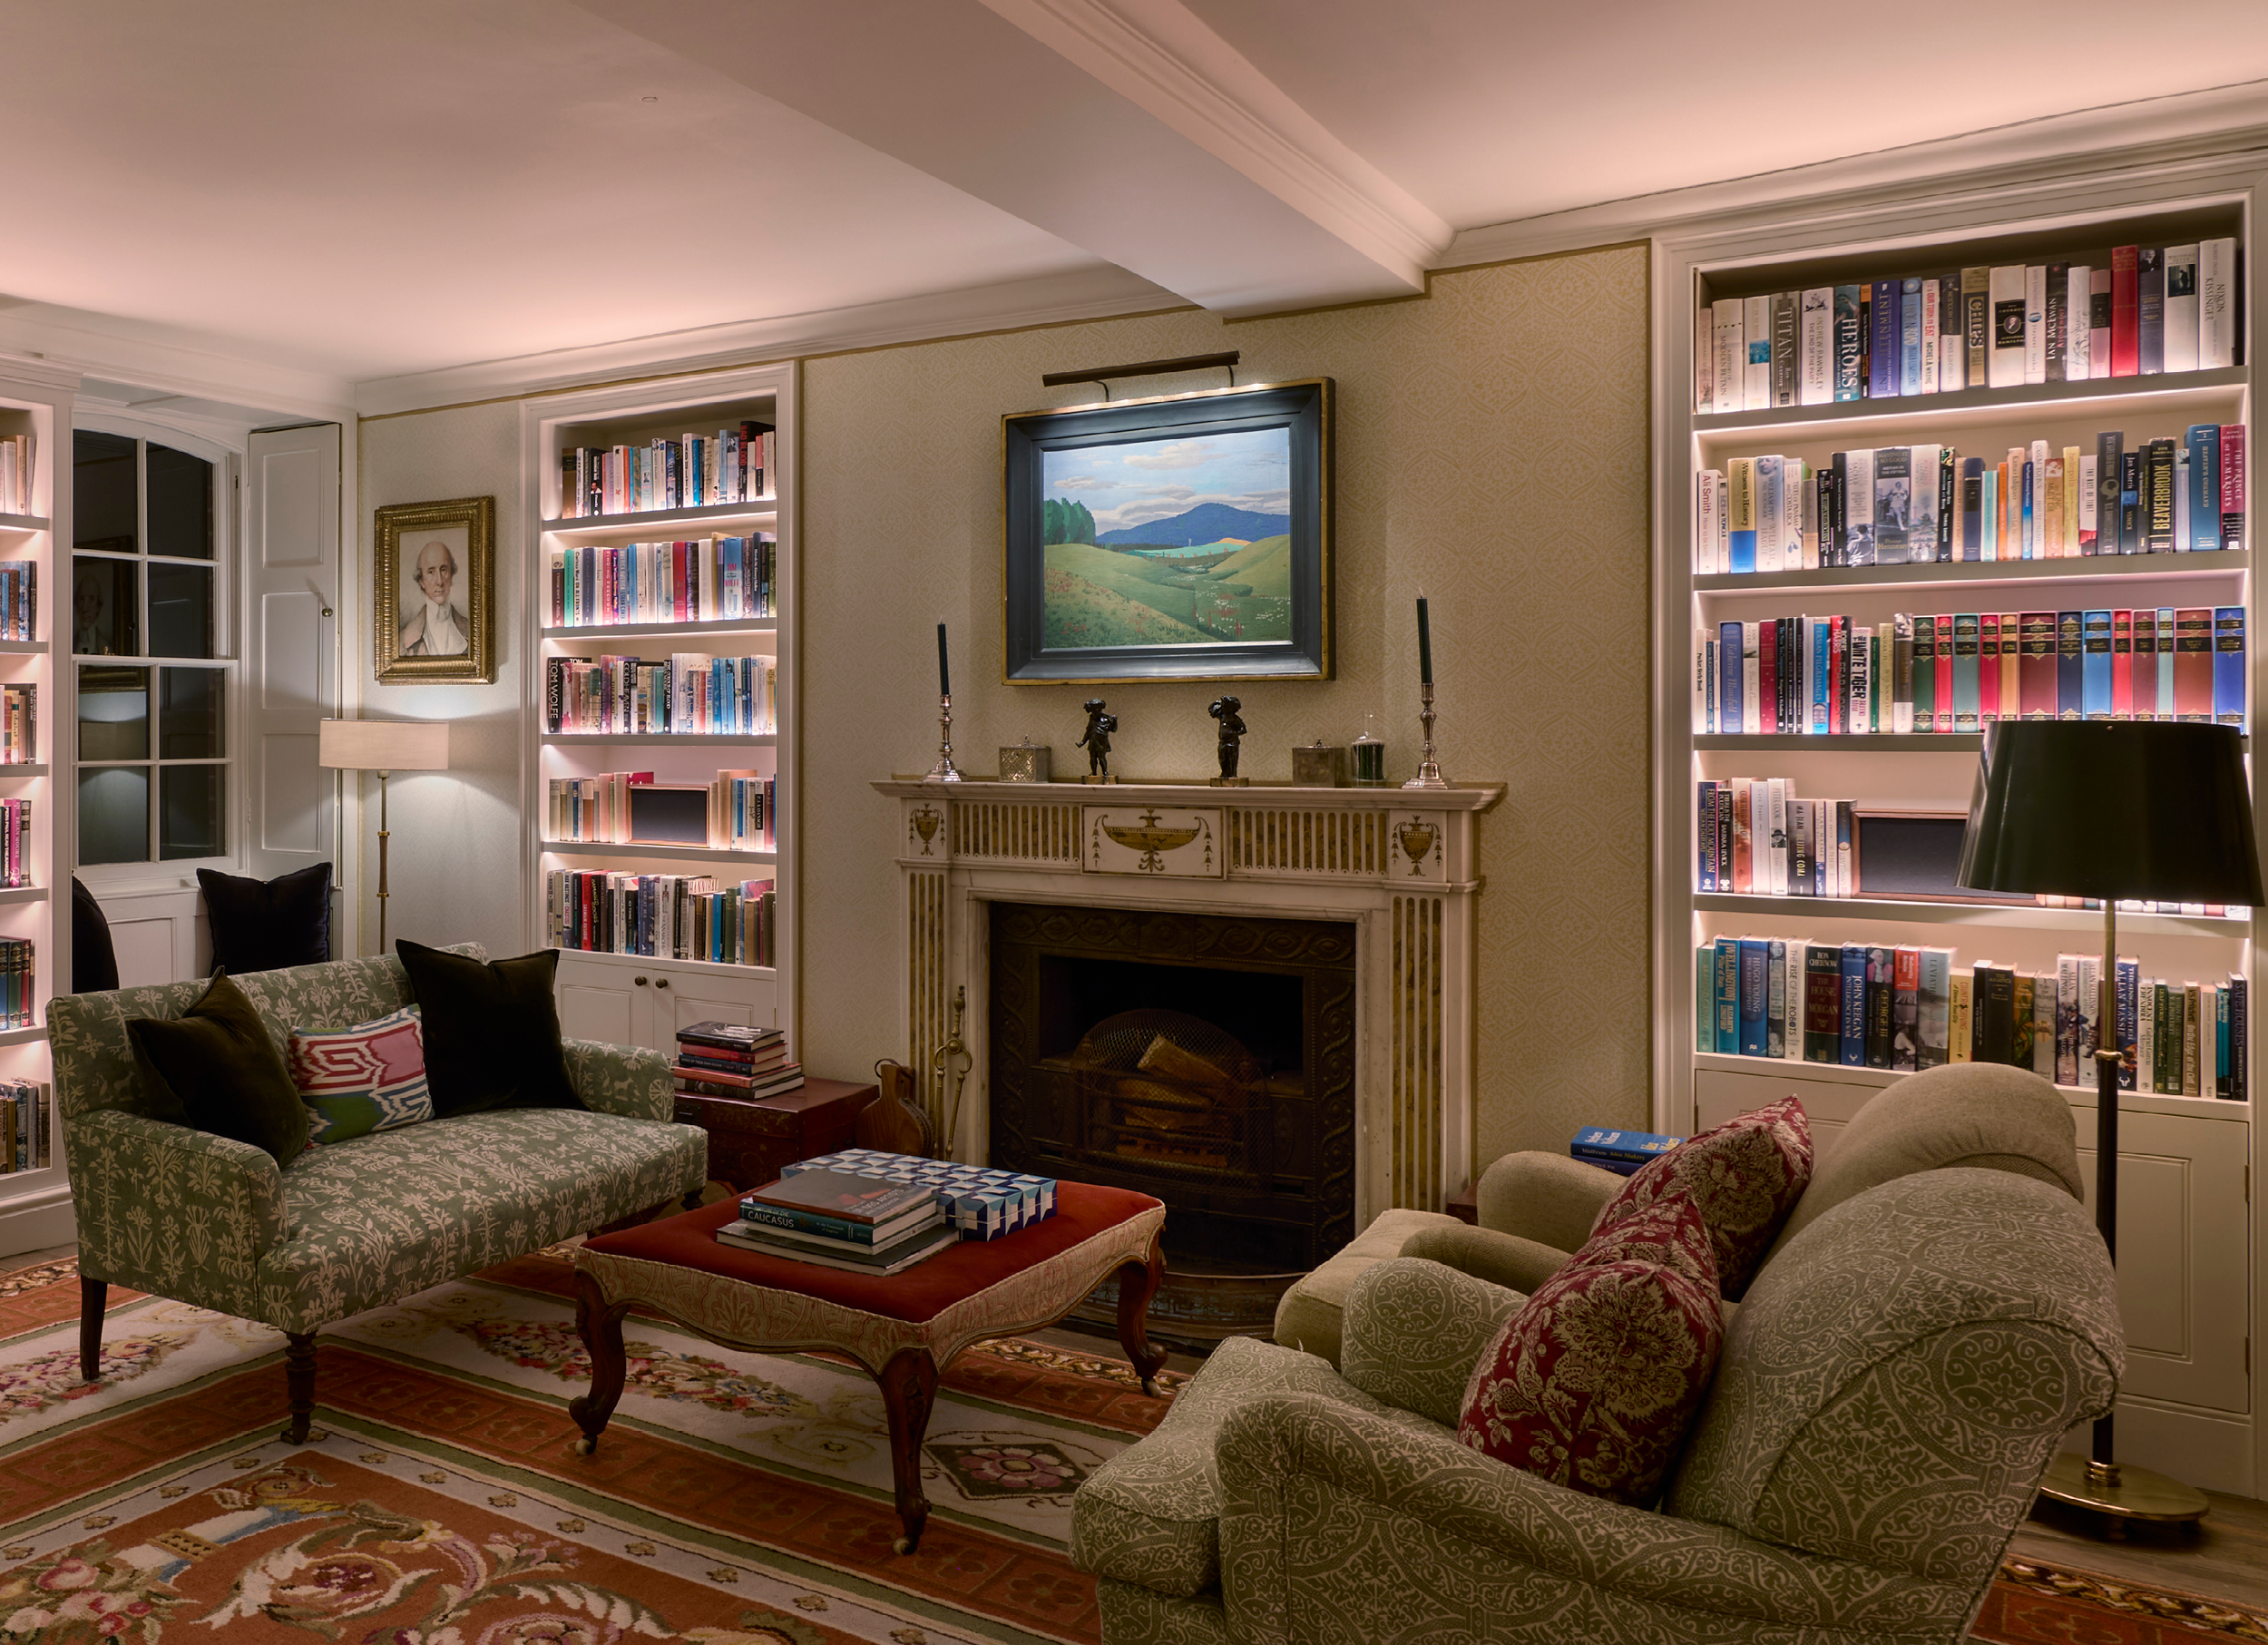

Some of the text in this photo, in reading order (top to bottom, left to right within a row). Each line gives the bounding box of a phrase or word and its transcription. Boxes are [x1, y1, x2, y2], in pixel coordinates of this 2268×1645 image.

[2204, 278, 2214, 321] KISSINGER
[2216, 284, 2225, 313] NIXON
[1778, 308, 1793, 358] TITAN
[1879, 293, 1888, 391] ENLIGHTENMENT
[1969, 299, 1984, 348] CHIPS
[1841, 318, 1858, 388] HEROES
[2067, 453, 2076, 487] heliopolis
[2224, 444, 2232, 452] OF
[1703, 475, 1711, 514] Ali Smith
[1741, 462, 1749, 491] Witness
[2010, 476, 2019, 500] Ishiguro
[2126, 456, 2135, 489] Jan Morris
[2234, 449, 2243, 501] THE PRINCE
[1740, 499, 1749, 527] History
[2153, 464, 2171, 530] BEAVERBROOK
[1833, 629, 1841, 653] HARRIS
[550, 661, 558, 719] TOM WOLFE
[1725, 643, 1737, 713] Katherine Mansfield
[1834, 661, 1845, 716] FEAR INDEX
[1852, 641, 1867, 699] WHITE TIGER
[1706, 788, 1715, 873] FROM THE HOLY MOUNTAIN
[1796, 806, 1805, 876] MA JIAN BEIJING COMA
[1725, 945, 1735, 998] WELLINGTON
[1809, 959, 1838, 967] CHERNOW
[1789, 950, 1797, 1035] THE RISE OF THE ROBOTS
[1808, 1004, 1838, 1014] MORGAN
[1811, 986, 1836, 995] HOUSE
[1853, 975, 1862, 1039] JOHN KEEGAN
[1880, 990, 1889, 1037] GEORGE III
[1960, 982, 1968, 1030] COUNTRY DRIVING
[2117, 970, 2126, 1037] ALLAN MASSIE
[2185, 1024, 2195, 1033] On
[2235, 984, 2244, 1046] SAFE HOUSES
[2185, 1042, 2195, 1054] Edge
[2185, 1062, 2195, 1071] the
[1582, 1148, 1607, 1156] Wolfram
[1624, 1152, 1645, 1160] Makers
[748, 1210, 794, 1228] CAUCASUS
